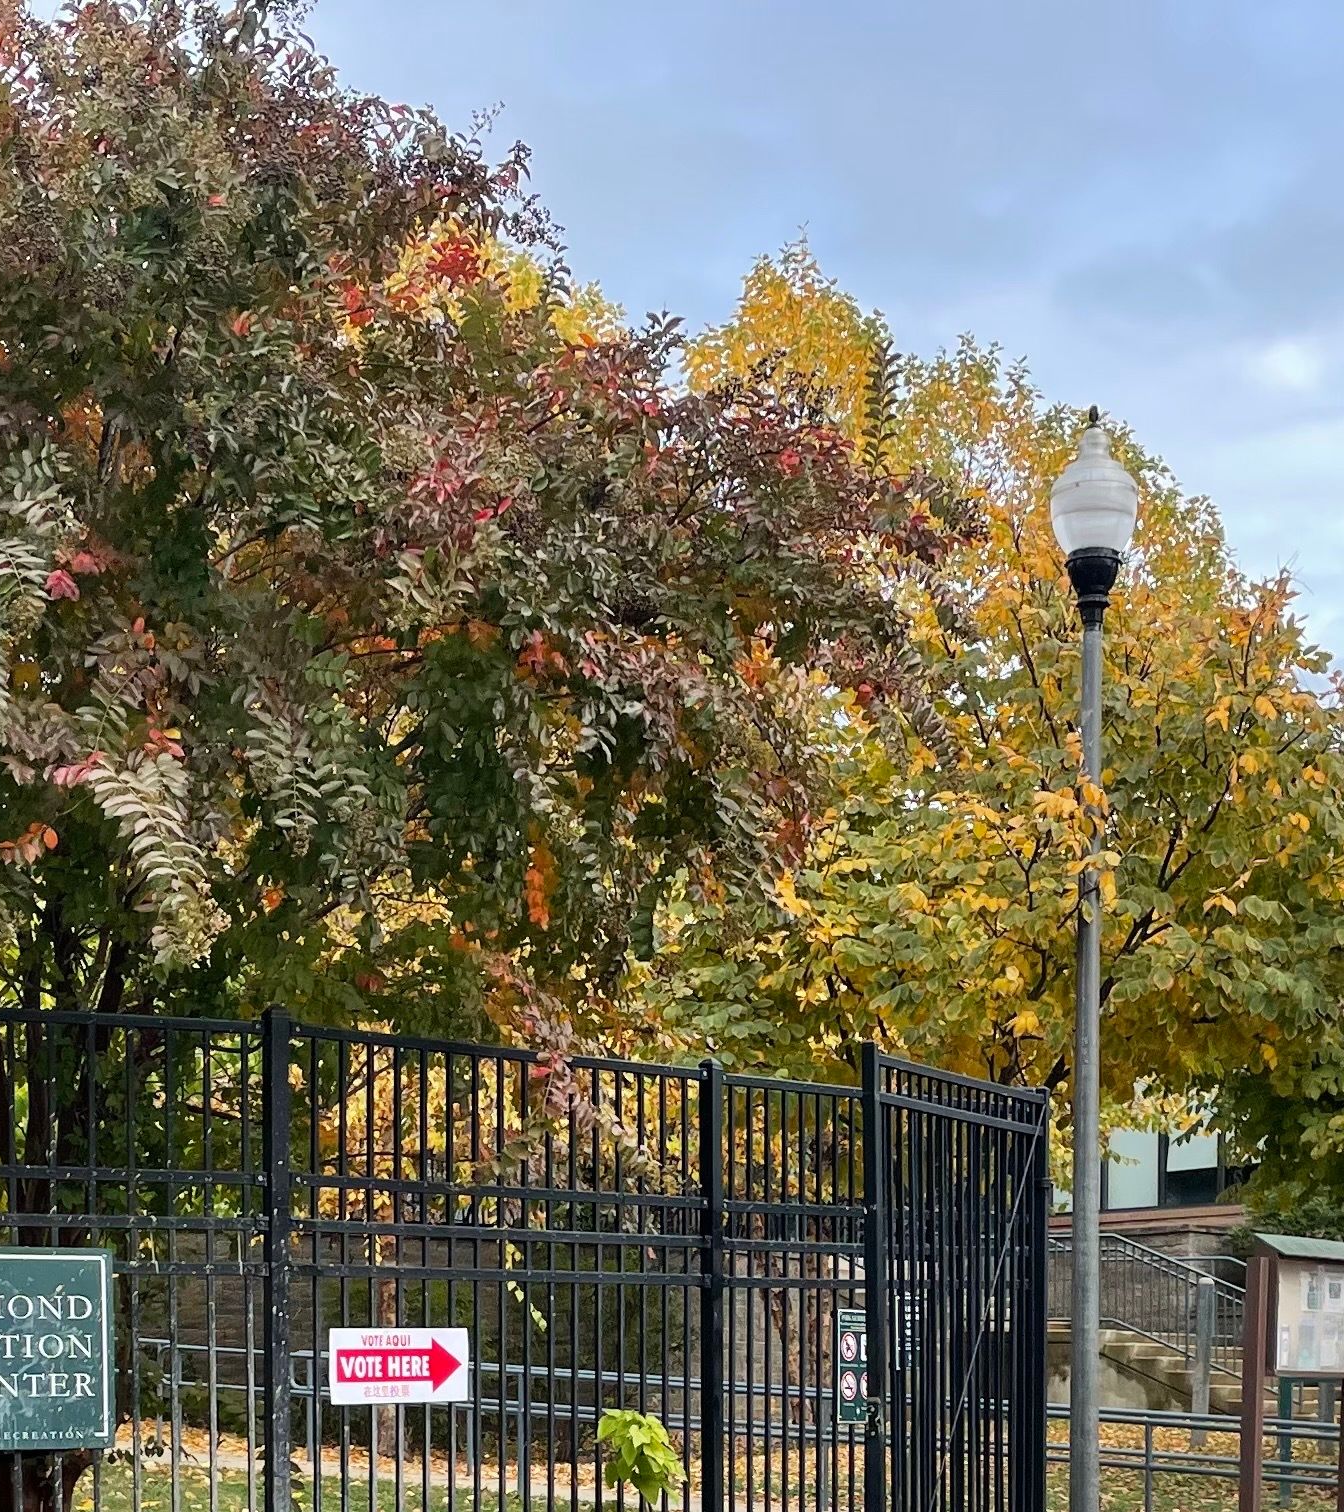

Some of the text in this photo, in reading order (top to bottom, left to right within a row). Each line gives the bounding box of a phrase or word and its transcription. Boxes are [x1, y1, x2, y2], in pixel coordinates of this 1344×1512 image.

[361, 1335, 410, 1346] VOTE AQUI
[340, 1356, 430, 1378] VOTE HERE
